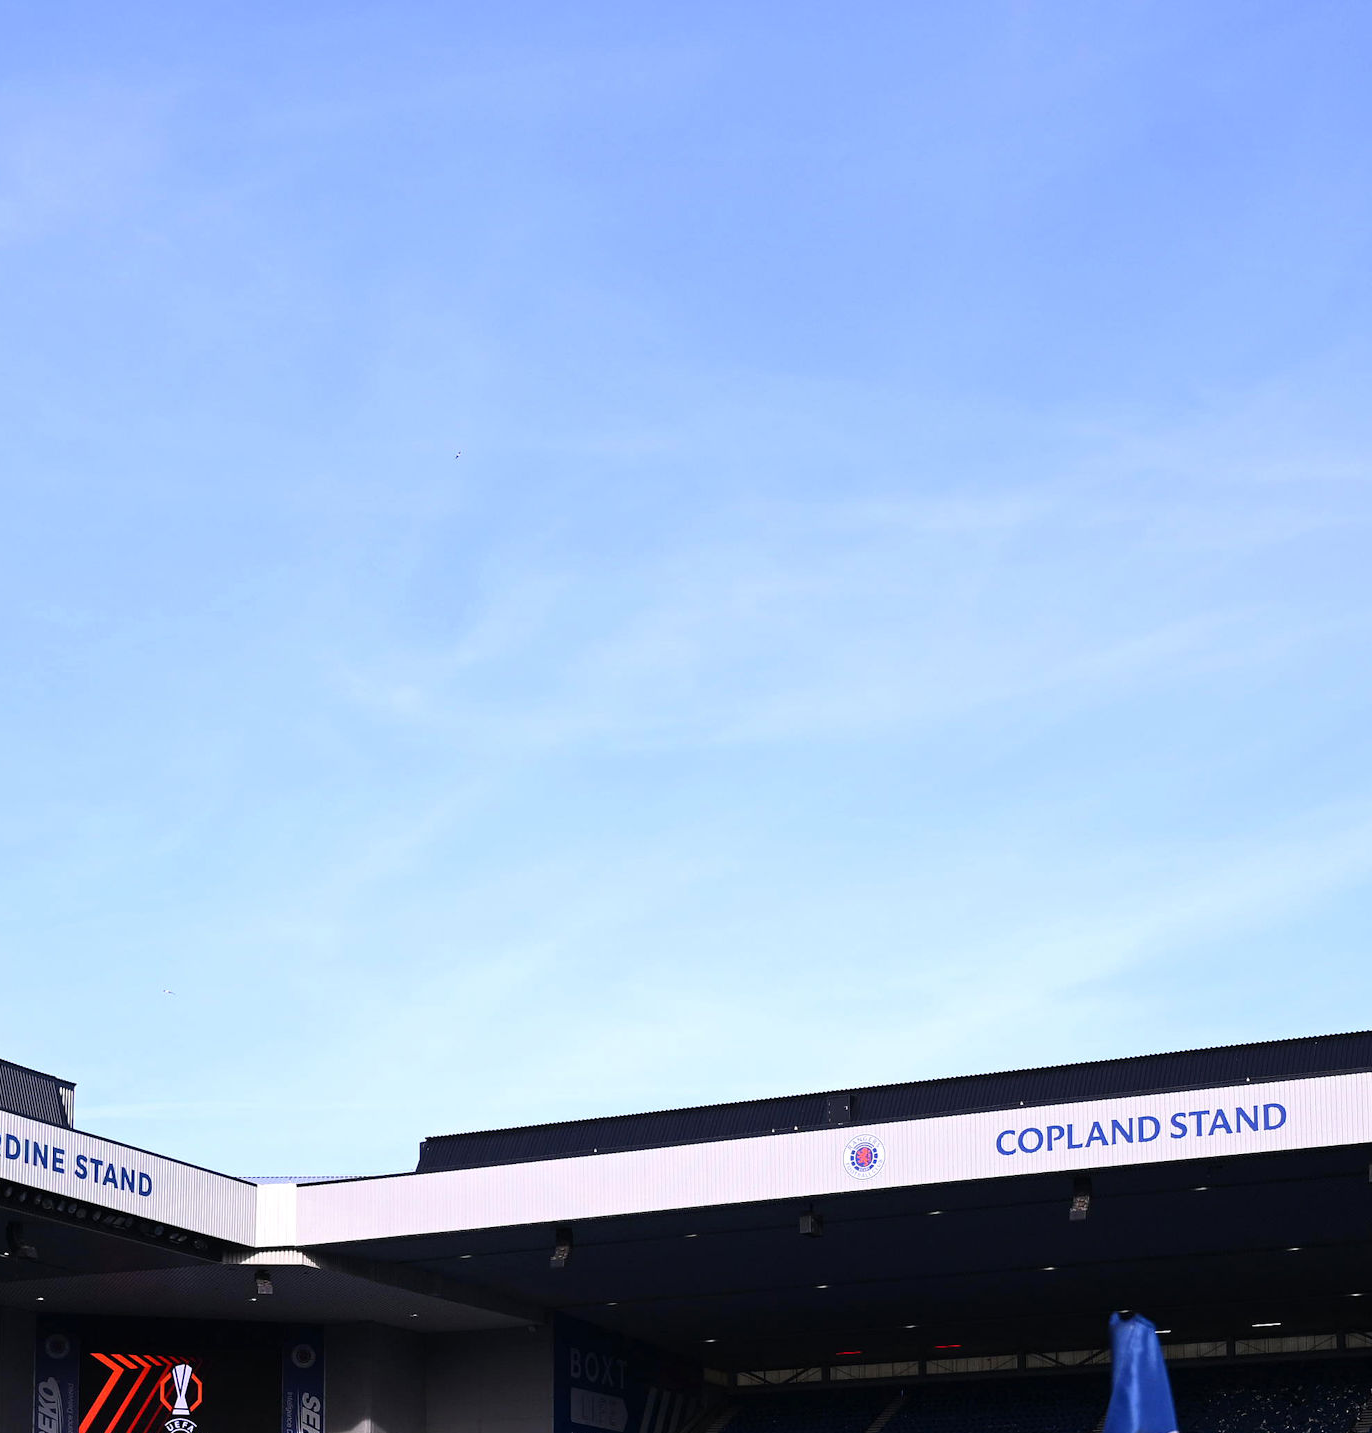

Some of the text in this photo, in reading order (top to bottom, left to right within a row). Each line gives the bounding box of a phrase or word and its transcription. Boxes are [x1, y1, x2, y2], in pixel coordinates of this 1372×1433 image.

[996, 1103, 1287, 1156] COPLAND STAND
[74, 1154, 153, 1197] STAND
[570, 1347, 628, 1389] BOXT
[166, 1421, 194, 1433] UEFA
